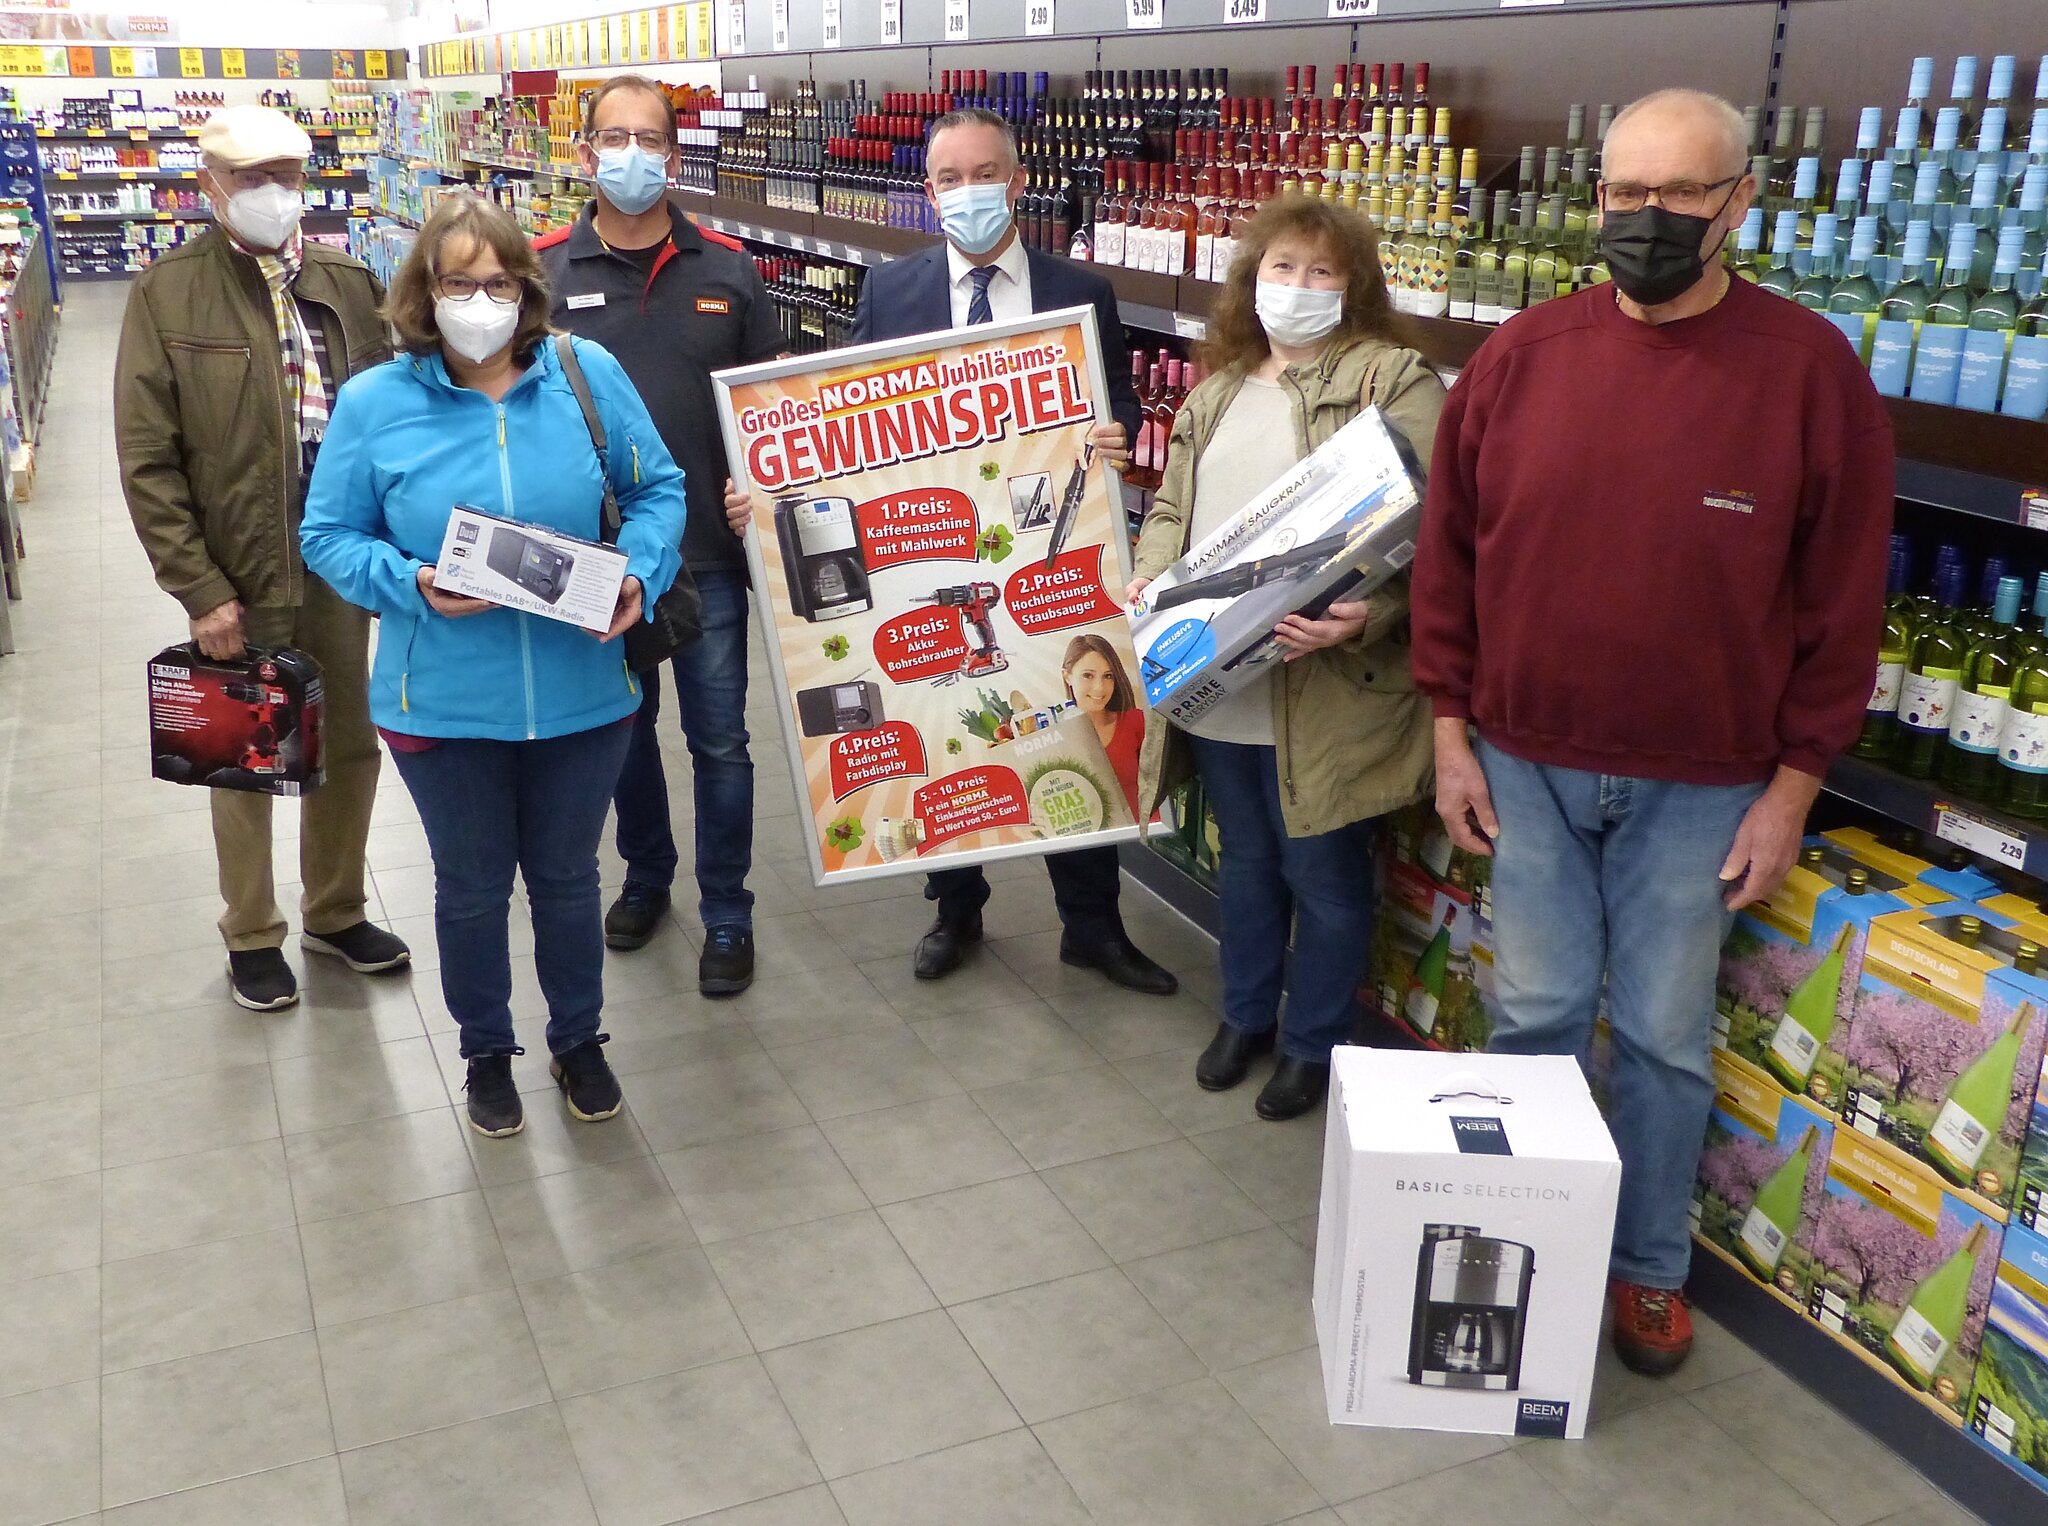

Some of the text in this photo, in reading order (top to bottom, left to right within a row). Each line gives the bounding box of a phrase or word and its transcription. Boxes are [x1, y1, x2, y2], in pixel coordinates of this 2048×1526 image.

[130, 23, 167, 31] NORMA
[1031, 8, 1047, 25] 2.99
[741, 346, 1062, 434] Großes NORMA Jubiläums-
[749, 367, 1088, 486] GEWINNSPIEL
[880, 497, 952, 520] 1.Preis:
[459, 525, 478, 540] Dual
[866, 517, 971, 539] Kaffeemaschine
[1187, 524, 1246, 574] MAXIMALE
[1248, 470, 1314, 527] SAUGKRAFT
[1207, 529, 1260, 573] schlankes
[1261, 495, 1301, 528] Design
[875, 534, 966, 556] mit Mahlwerk
[460, 581, 503, 600] Portables
[1018, 567, 1083, 594] 2.Preis:
[1011, 584, 1098, 612] Hochleistungs-
[1022, 600, 1096, 626] Staubsauger
[887, 618, 950, 644] 3.Preis:
[1156, 621, 1192, 653] INKLUSIVE
[887, 646, 965, 672] Bohrschrauber
[907, 639, 939, 654] Akku-
[162, 666, 188, 675] KRAFT
[1171, 680, 1221, 717] PRIME
[1181, 687, 1227, 723] EVERYDAY
[838, 731, 900, 755] 4.Preis:
[1013, 729, 1064, 757] NORMA
[847, 747, 899, 768] Radio mit
[846, 760, 907, 782] Farbdisplay
[940, 783, 956, 796] 10.
[957, 775, 988, 791] Preis:
[925, 790, 989, 817] je ein NORMA
[935, 794, 1013, 823] Einkaufsgutschein
[1042, 788, 1085, 815] GRAS
[934, 827, 945, 836] im
[945, 821, 965, 832] Wert
[965, 815, 981, 826] von
[998, 803, 1020, 817] Euro!
[1048, 806, 1090, 828] PAPIER
[2000, 842, 2023, 860] 2.29
[1890, 940, 1959, 980] DEUTSCHLAND
[1457, 1122, 1499, 1131] BEEM
[1853, 1149, 1917, 1194] DEUTSCHLAND
[1396, 1180, 1571, 1201] BASIC SELECTION
[1522, 1403, 1564, 1417] BEEM
